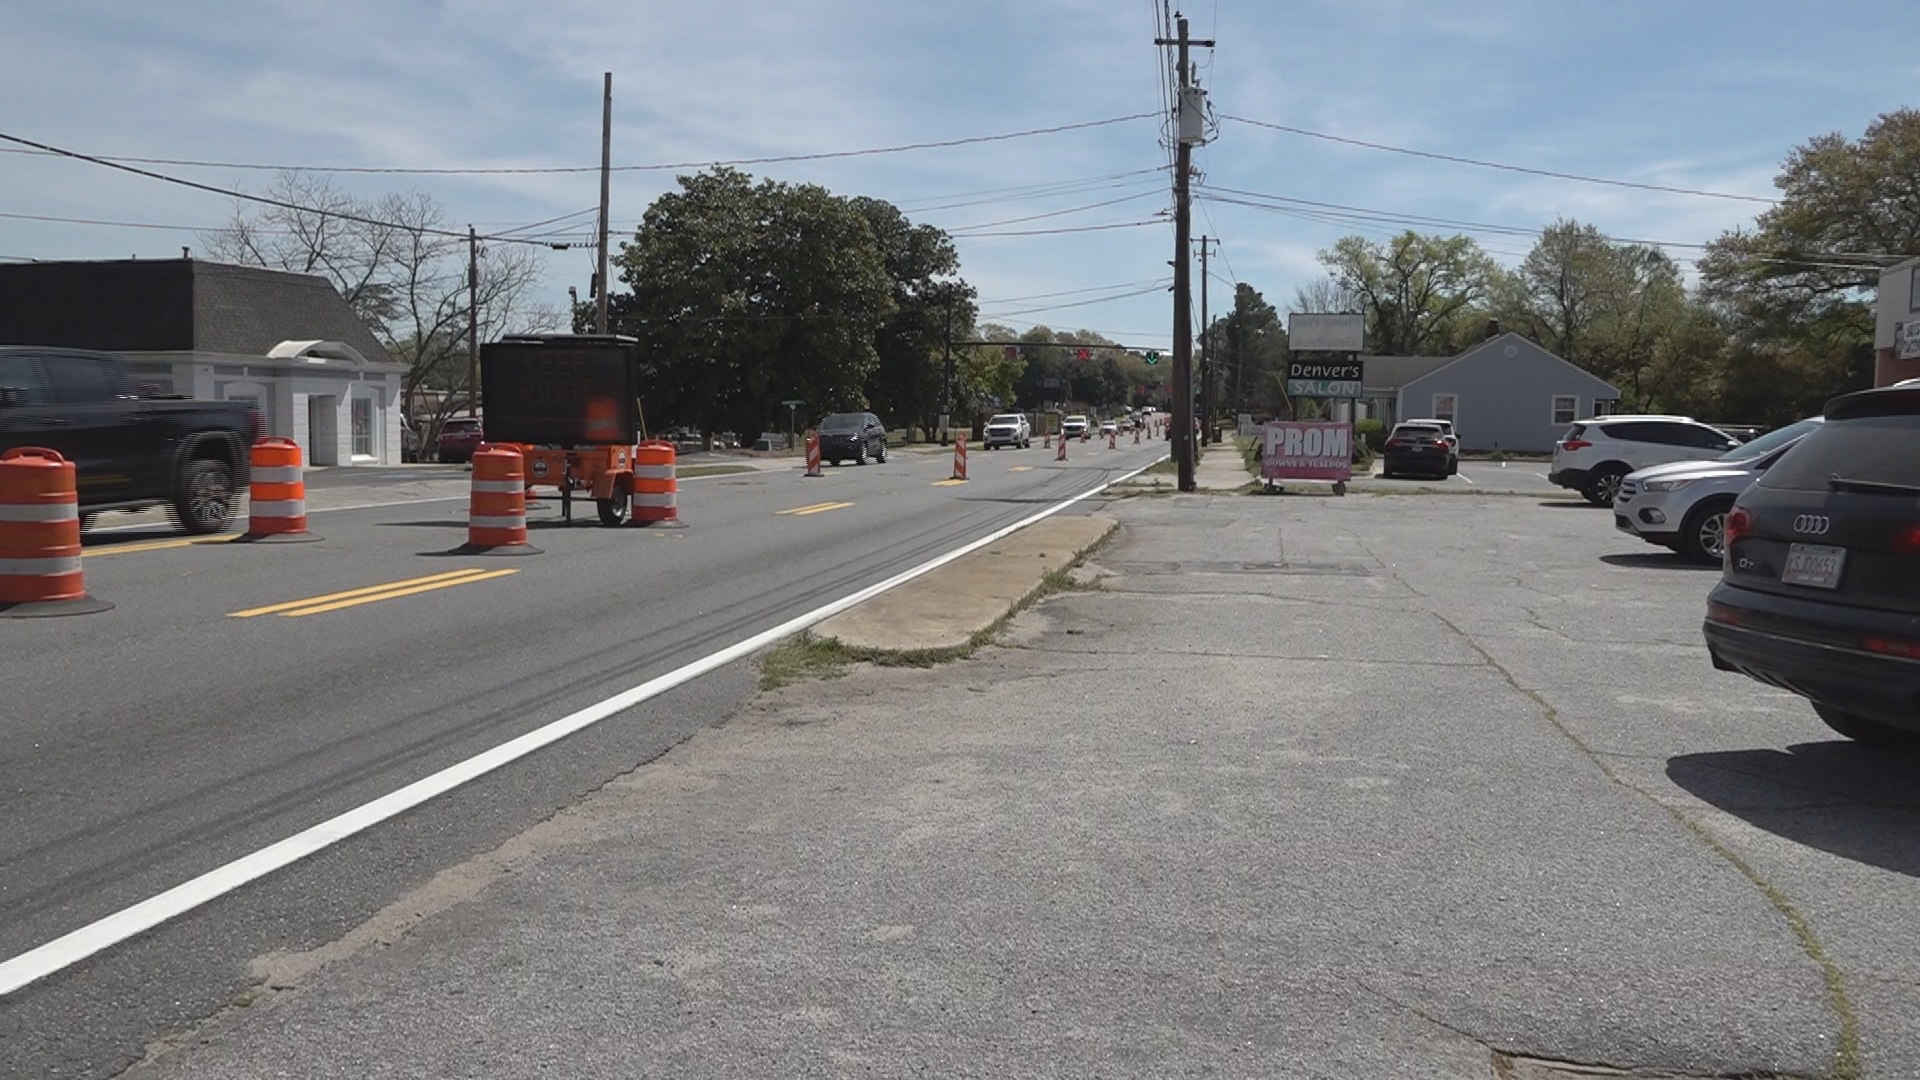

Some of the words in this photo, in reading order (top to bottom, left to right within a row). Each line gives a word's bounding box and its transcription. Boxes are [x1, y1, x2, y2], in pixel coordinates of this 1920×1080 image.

[523, 350, 584, 375] KEEP
[1291, 363, 1359, 378] Denver's
[520, 378, 591, 402] RIGHT
[1294, 381, 1355, 395] SALON
[1266, 427, 1348, 456] PROM
[1308, 460, 1349, 469] TUXEDOS
